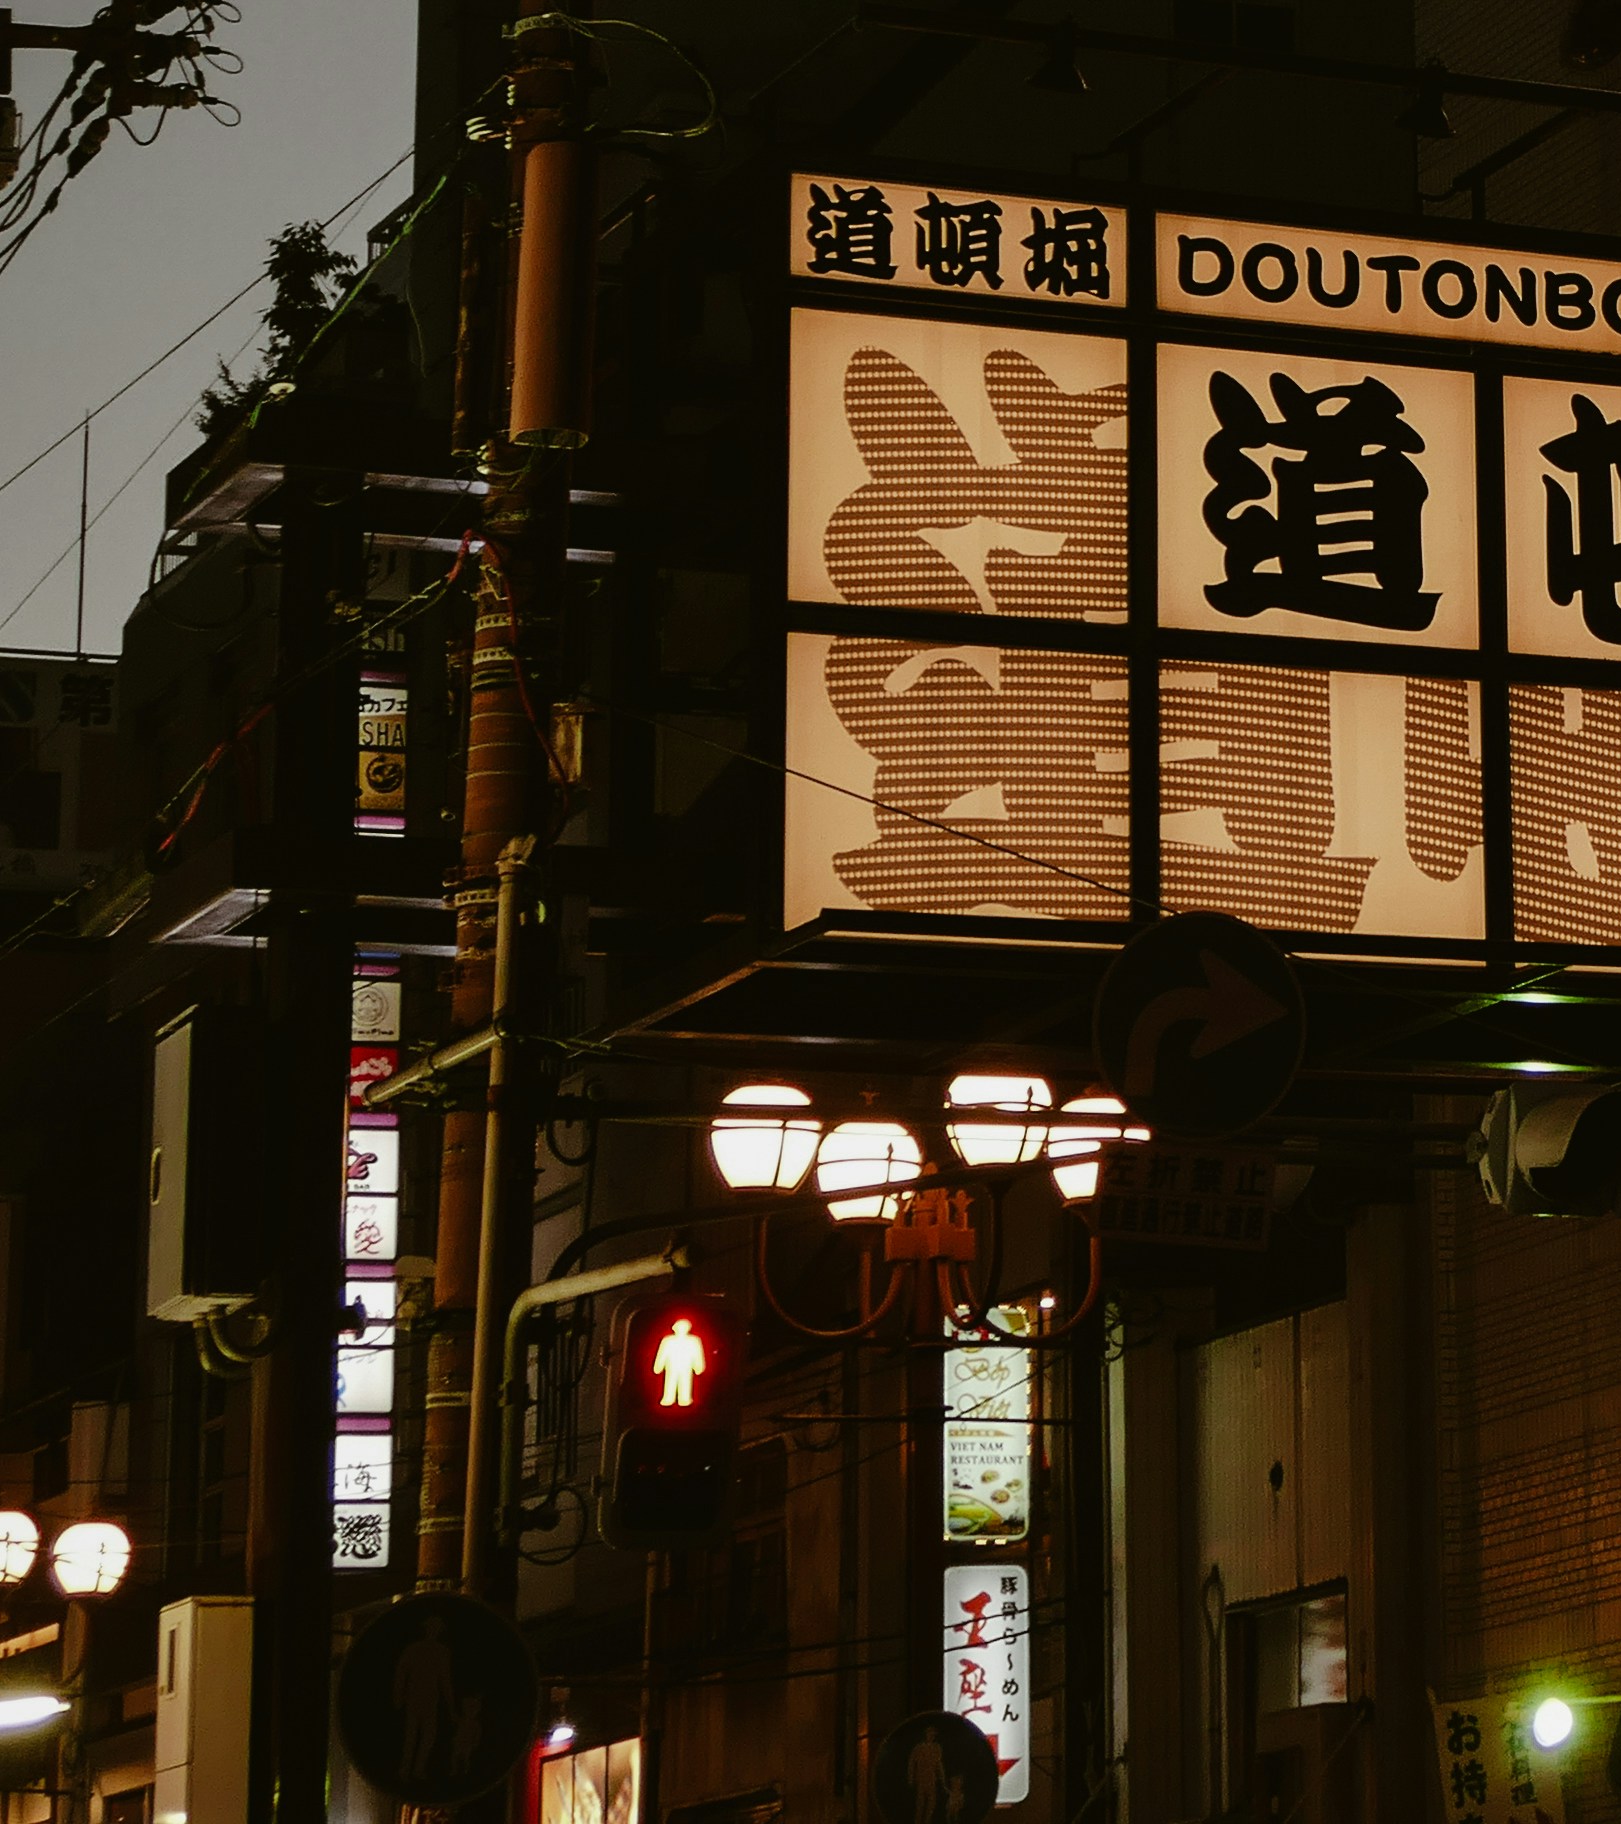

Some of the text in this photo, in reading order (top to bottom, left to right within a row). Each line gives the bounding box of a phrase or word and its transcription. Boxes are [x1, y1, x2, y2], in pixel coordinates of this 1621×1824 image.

[807, 182, 1110, 300] 道頓堀
[950, 1441, 1004, 1452] VIET NAM
[950, 1454, 1025, 1466] RESTAURANT
